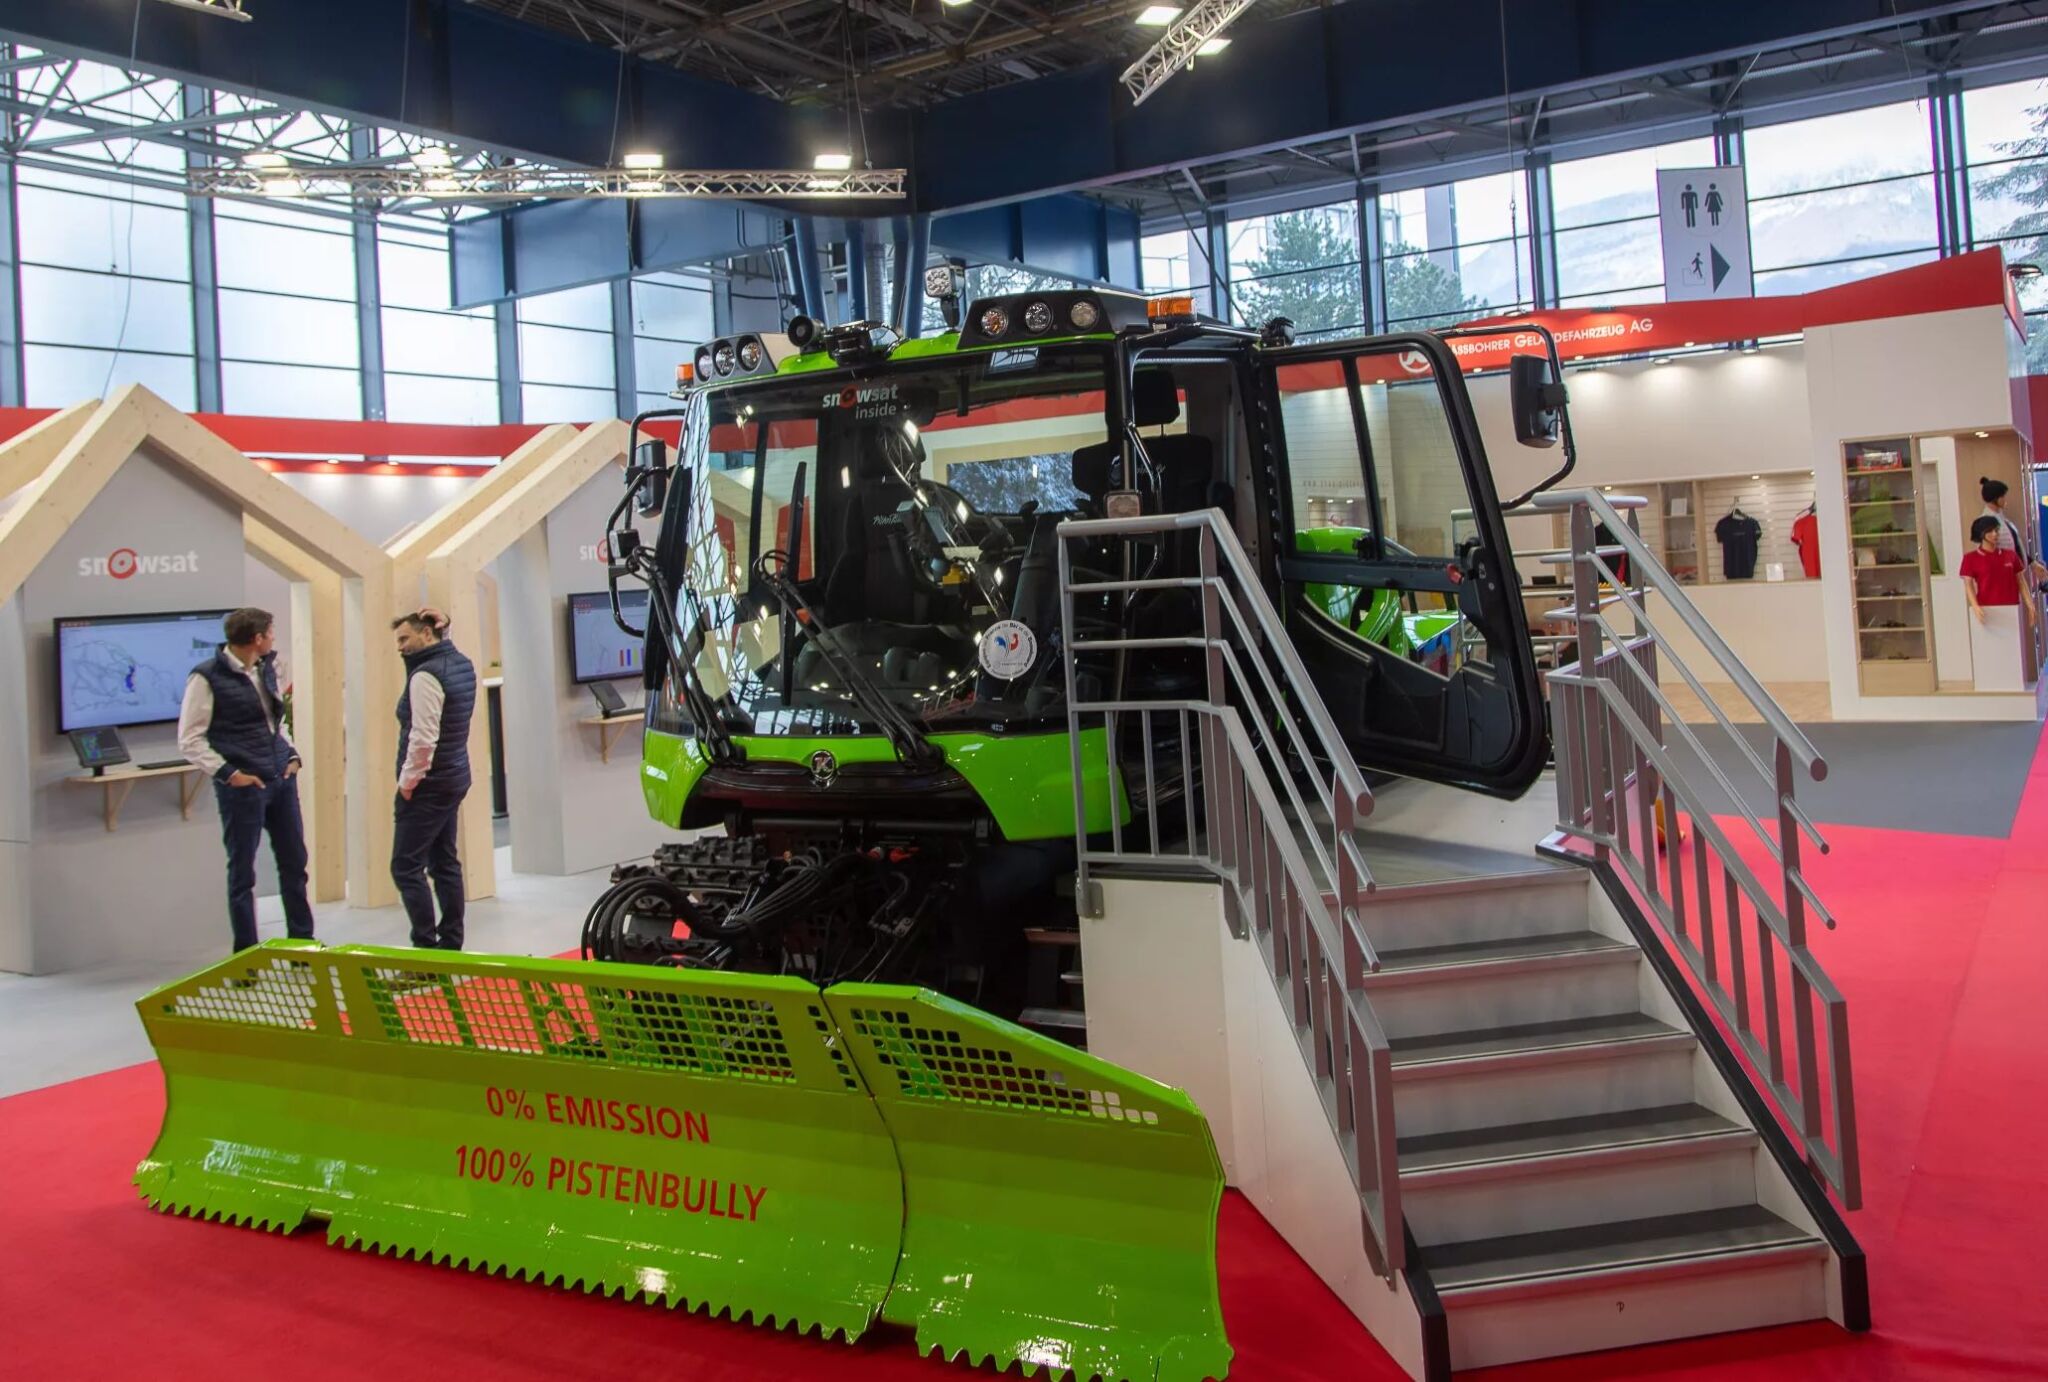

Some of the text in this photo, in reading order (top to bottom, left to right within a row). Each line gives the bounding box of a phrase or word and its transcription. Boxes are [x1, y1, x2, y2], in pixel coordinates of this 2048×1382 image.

[1629, 318, 1653, 334] AG
[822, 384, 899, 408] snowsat
[855, 402, 897, 419] inside
[78, 548, 199, 579] snowsat
[486, 1086, 711, 1144] 0% EMISSION
[456, 1145, 768, 1223] 100% PISTENBULLY
